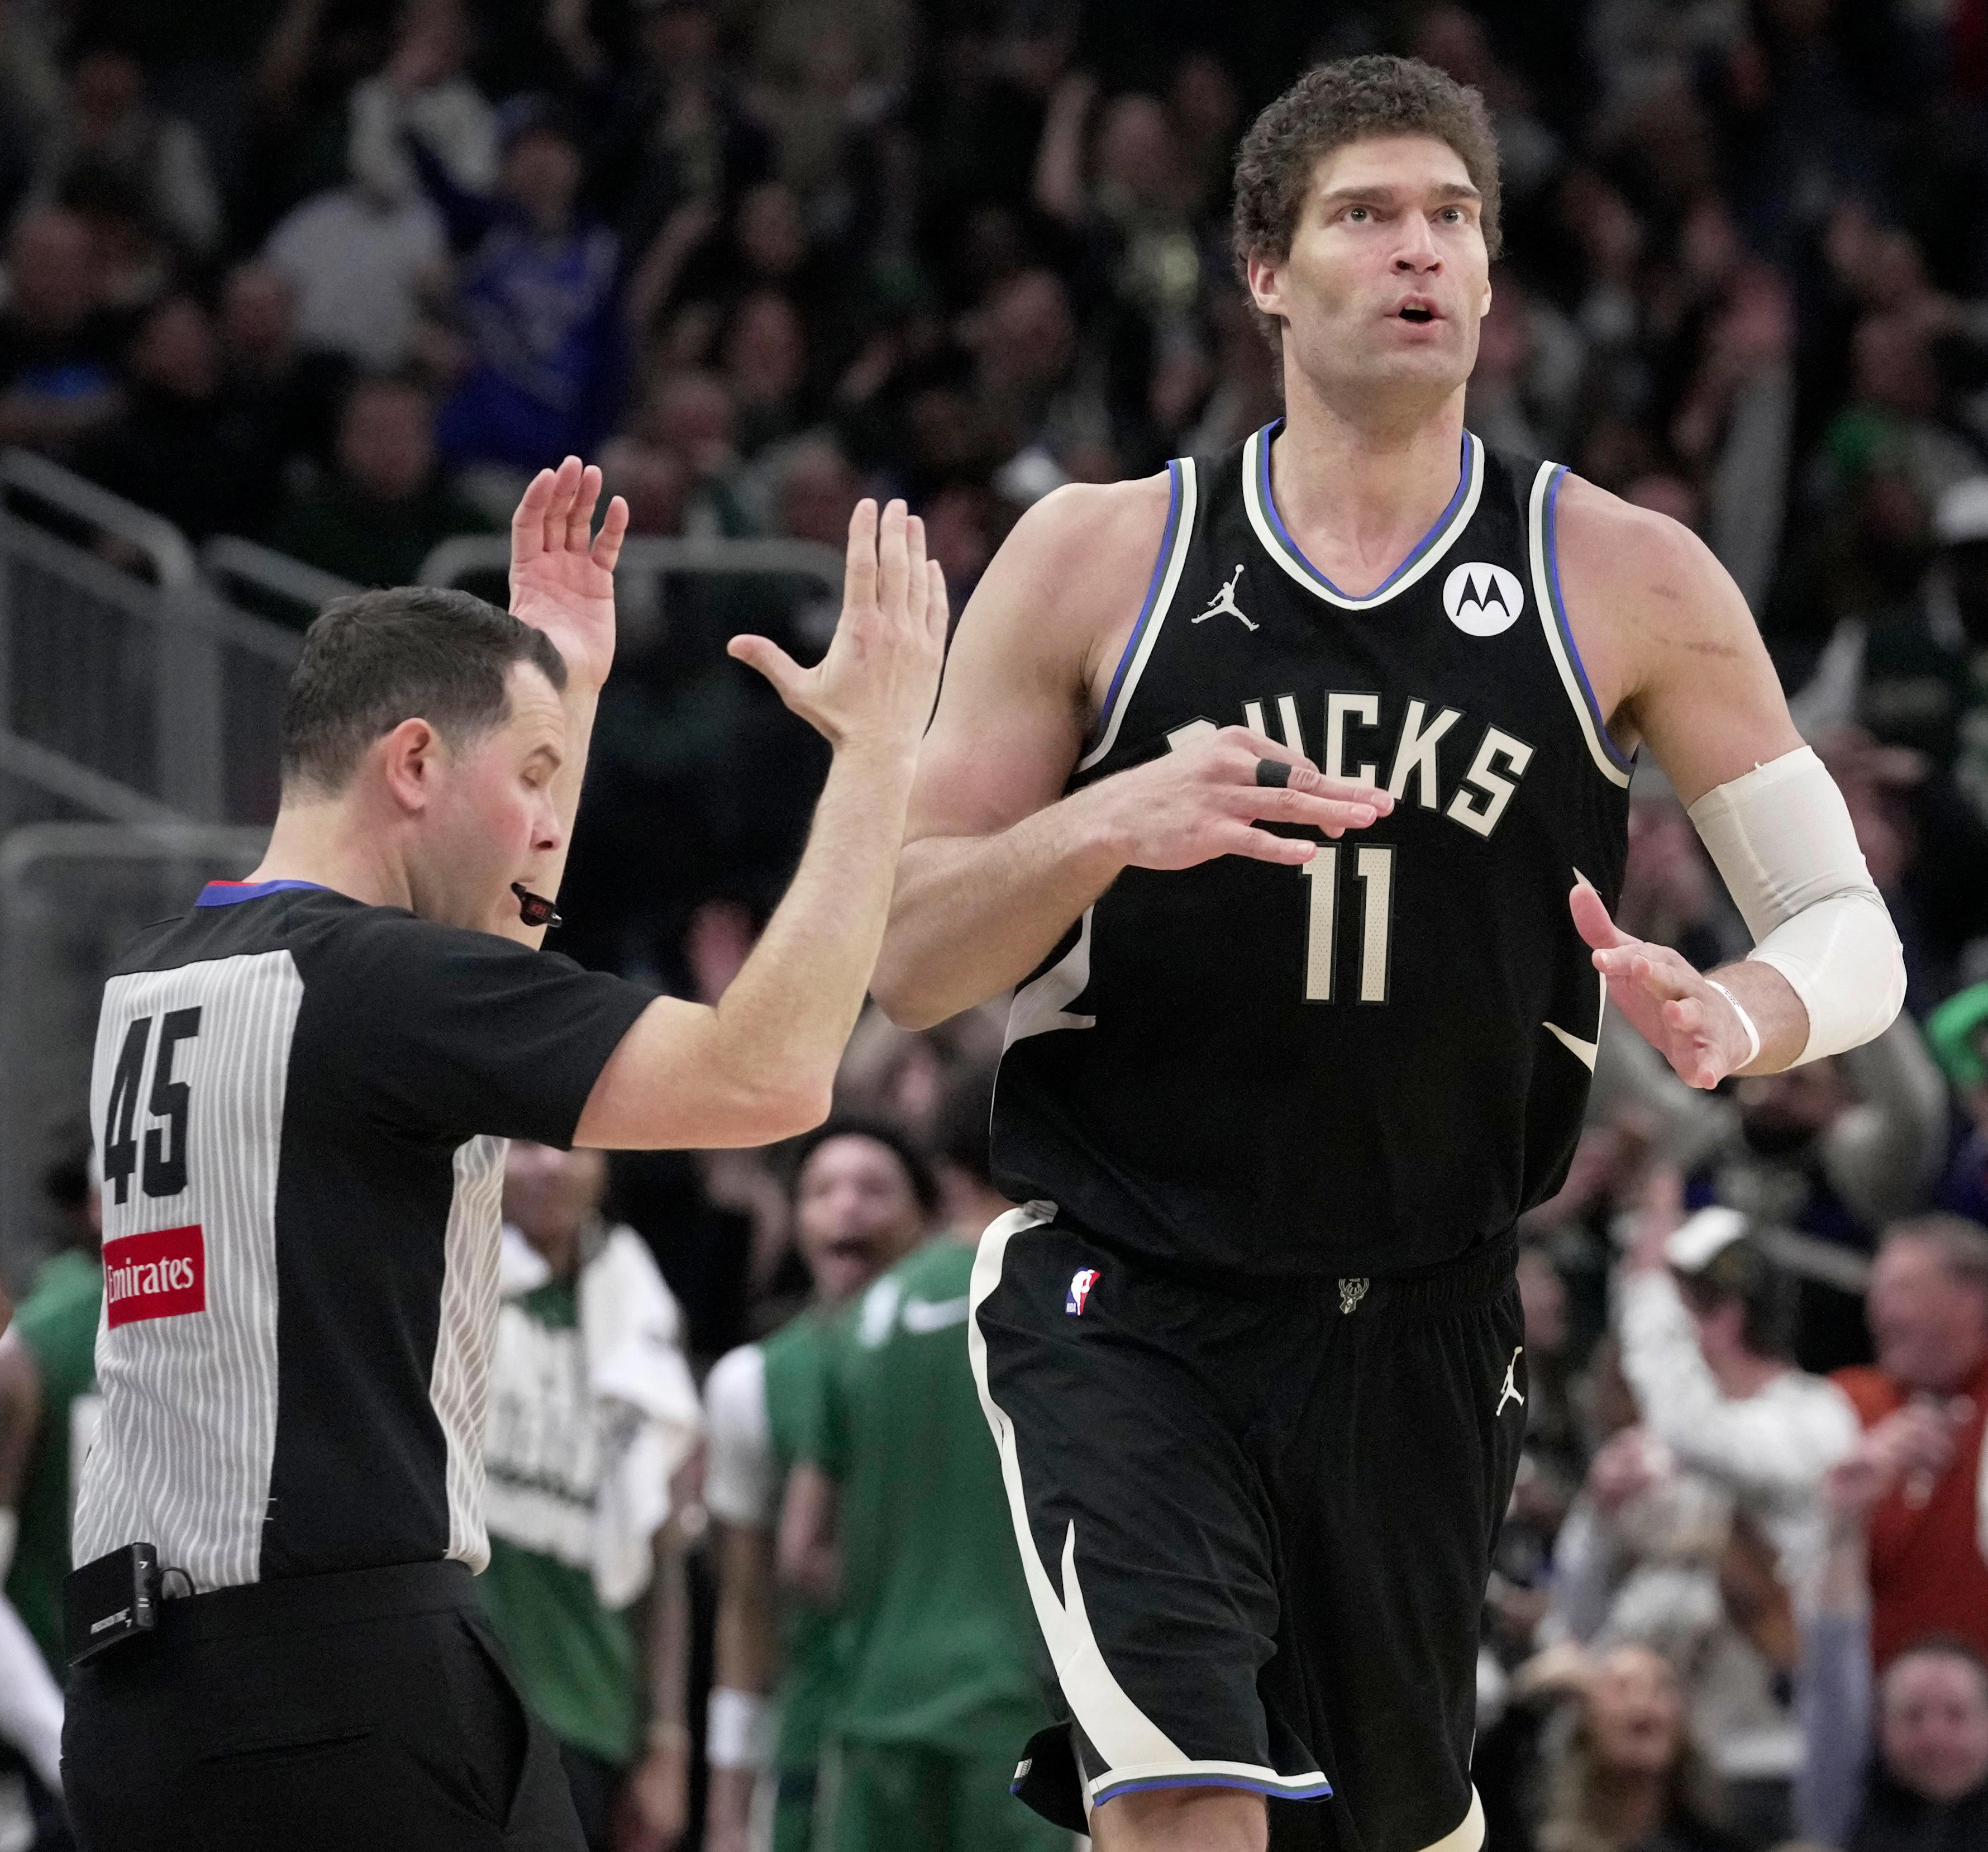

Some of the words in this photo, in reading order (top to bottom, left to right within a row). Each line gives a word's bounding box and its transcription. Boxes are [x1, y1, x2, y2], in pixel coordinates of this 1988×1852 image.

[1297, 842, 1396, 1004] 11
[104, 1006, 203, 1204] 45
[108, 1256, 194, 1303] Emirates
